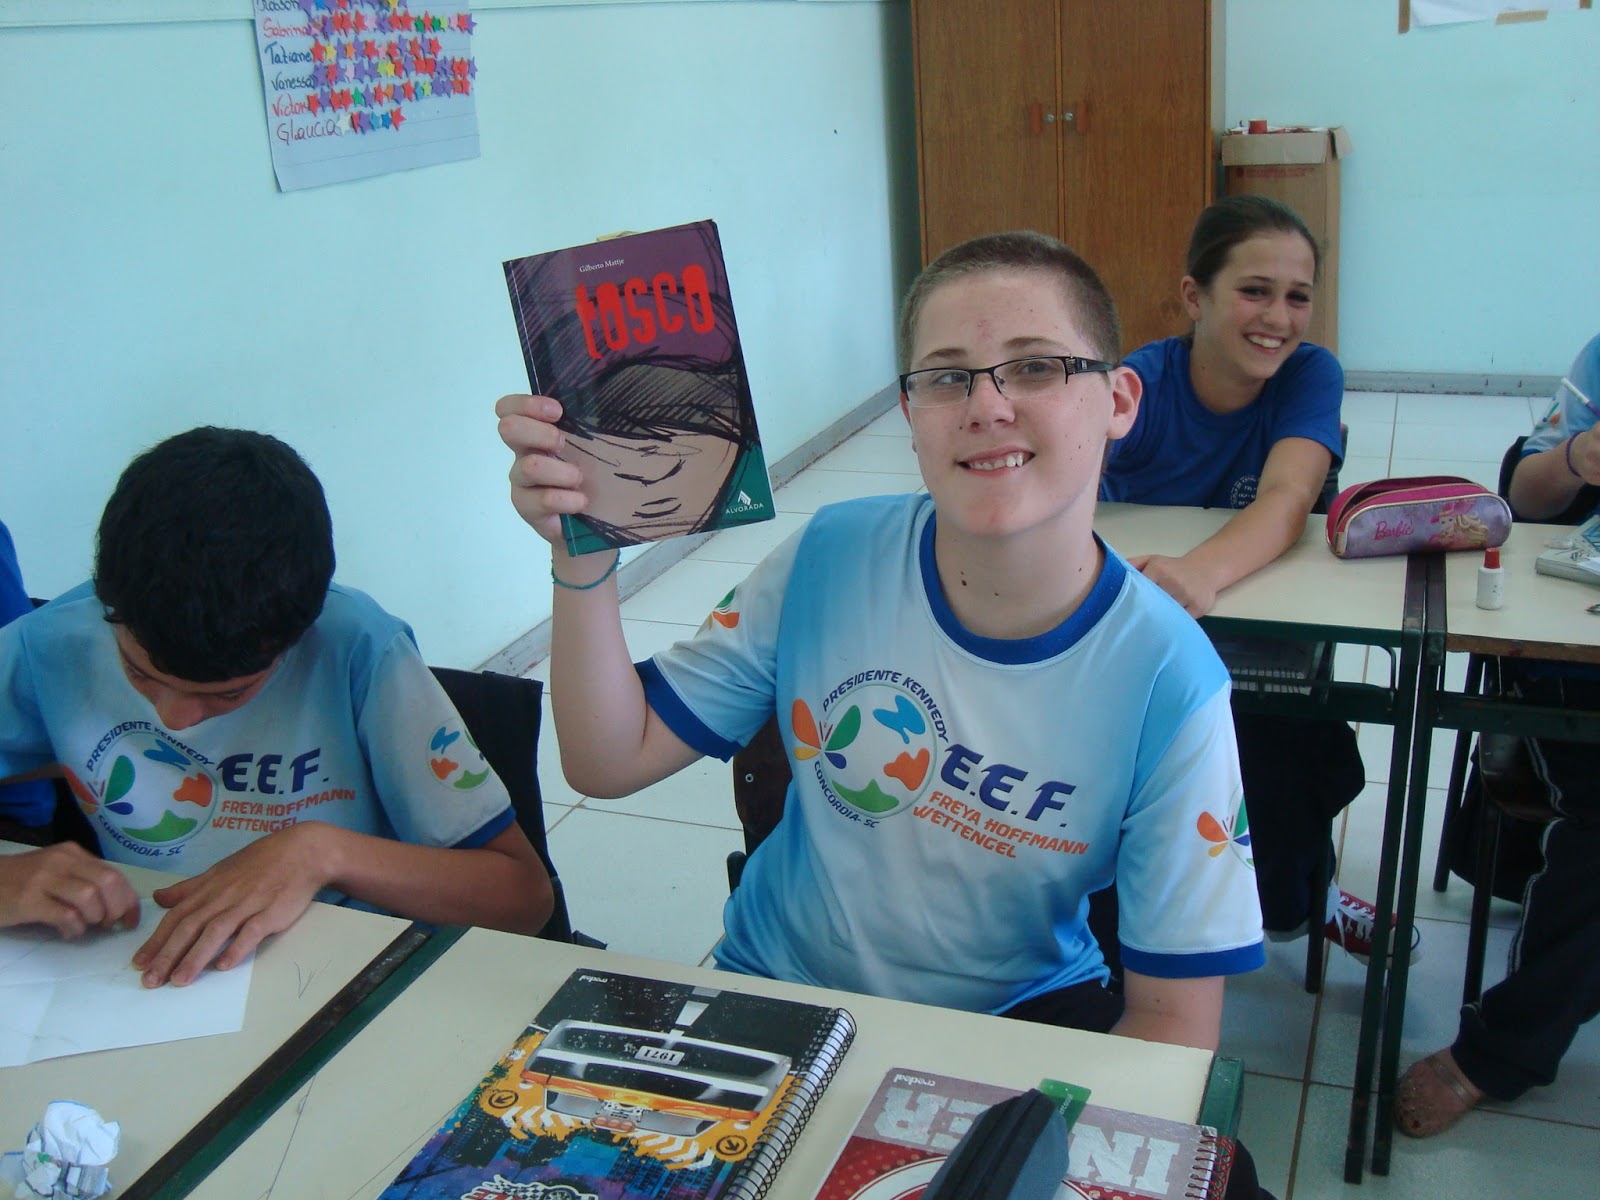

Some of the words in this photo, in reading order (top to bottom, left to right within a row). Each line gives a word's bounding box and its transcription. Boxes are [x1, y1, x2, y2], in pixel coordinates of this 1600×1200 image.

[263, 17, 308, 38] Sabrina
[264, 41, 312, 65] Tatiane
[271, 71, 315, 91] Vanessa
[579, 263, 604, 273] Gilberto
[605, 258, 625, 268] Mattje
[725, 502, 764, 515] ALVORADA
[1374, 520, 1414, 541] Barbie
[823, 669, 903, 712] PRESIDENTE
[902, 677, 949, 743] KENNEDY
[86, 720, 152, 772] PRESIDENTE
[154, 727, 215, 766] KENNEDY
[221, 800, 264, 815] FREYA
[266, 788, 356, 817] HOFFMANN
[864, 819, 881, 829] SC
[912, 805, 1017, 859] WETTENGEL
[928, 791, 983, 826] FREYA
[984, 818, 1090, 855] HOFFMANN
[166, 844, 186, 857] SC
[643, 1049, 676, 1062] 1971
[874, 1086, 1181, 1196] INER
